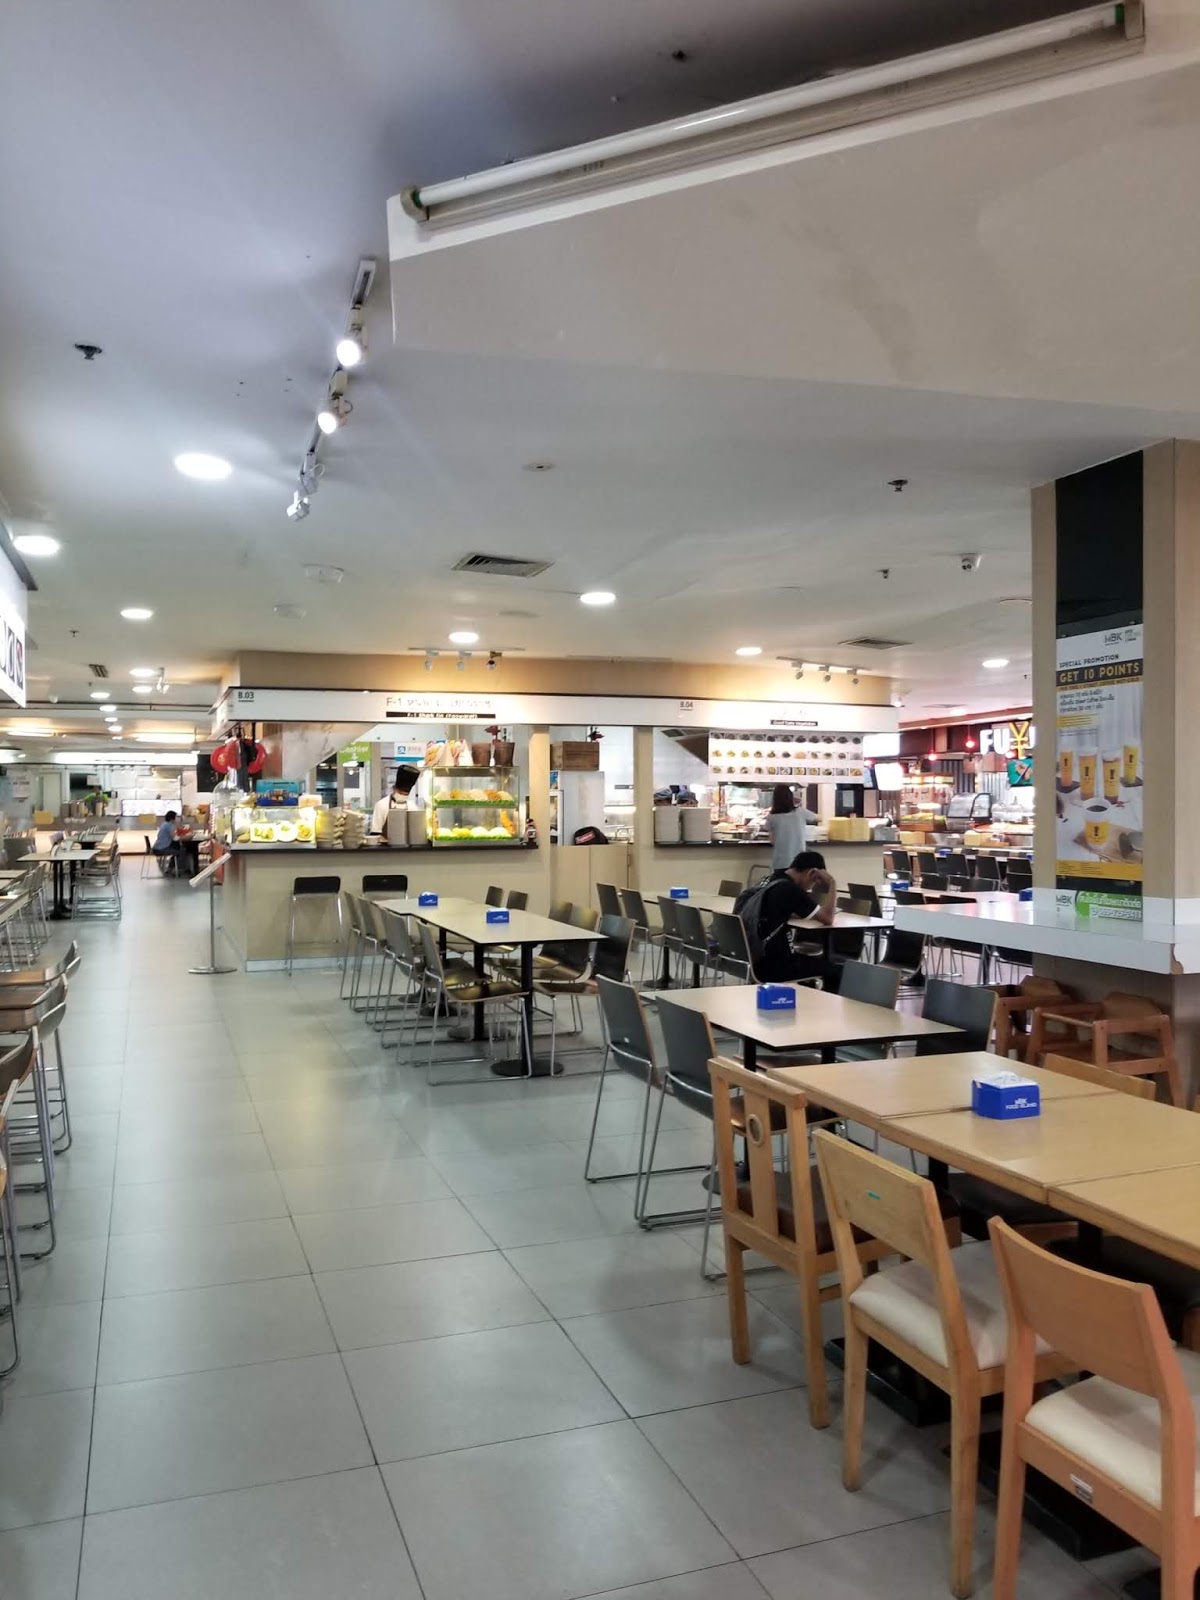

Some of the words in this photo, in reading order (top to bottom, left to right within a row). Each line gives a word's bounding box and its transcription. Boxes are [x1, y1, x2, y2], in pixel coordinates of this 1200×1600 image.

[1059, 661, 1081, 669] SPECIAL
[1083, 653, 1119, 664] PROMOTION
[1060, 670, 1079, 683] GET
[1084, 668, 1094, 680] 10
[1099, 662, 1140, 678] POINTS
